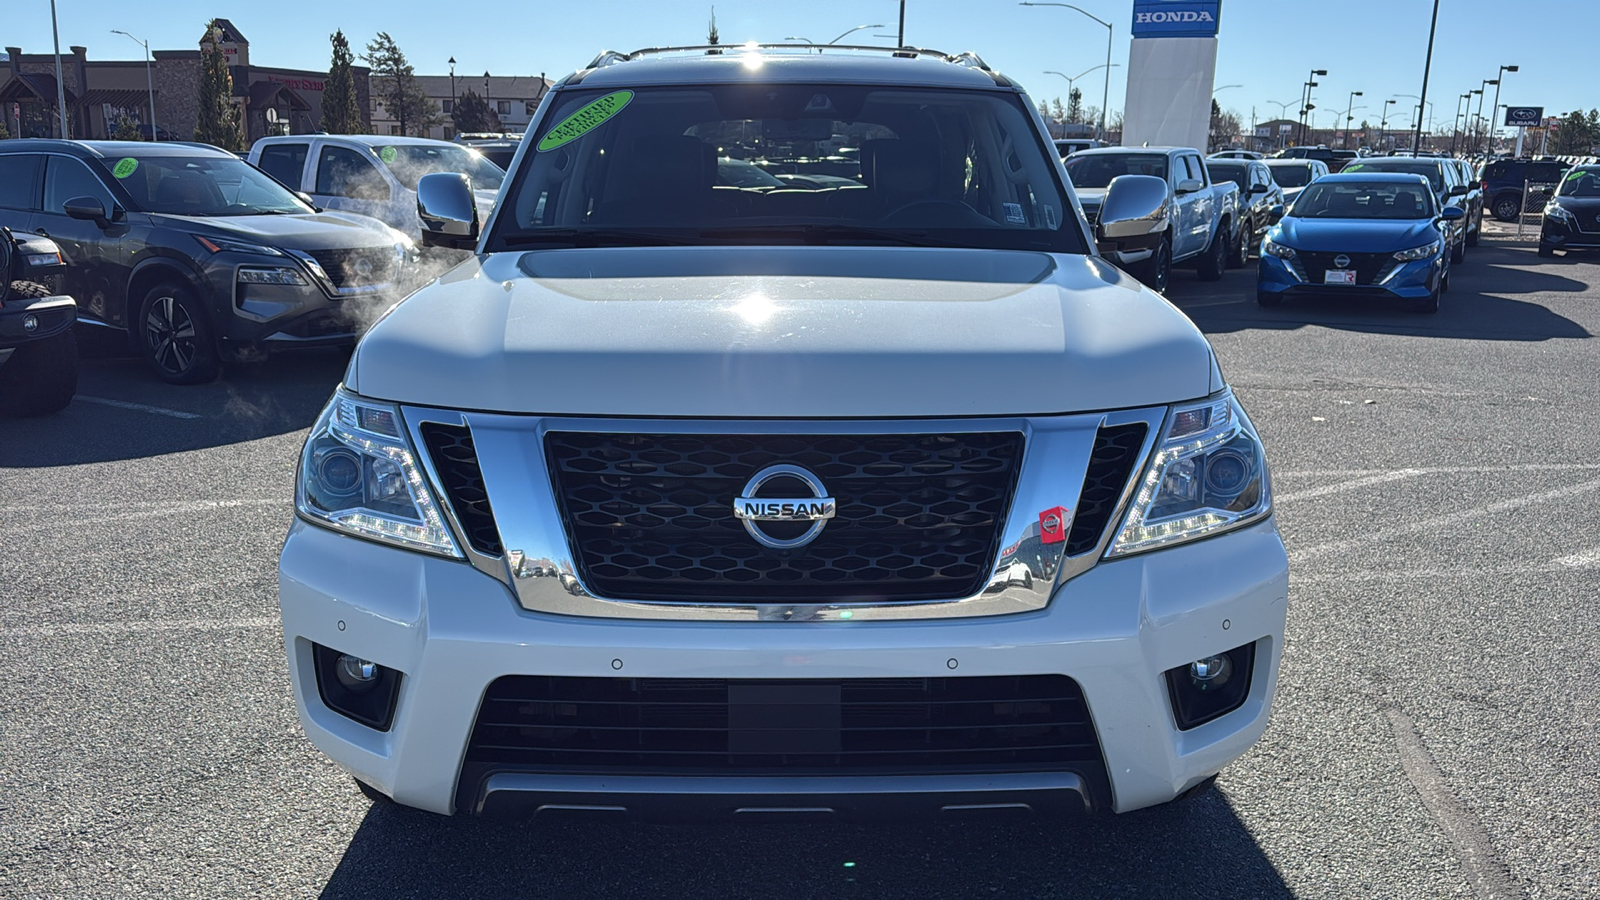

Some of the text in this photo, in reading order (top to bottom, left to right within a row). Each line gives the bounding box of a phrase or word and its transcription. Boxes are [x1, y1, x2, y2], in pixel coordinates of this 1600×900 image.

[1135, 11, 1214, 23] HONDA
[547, 95, 615, 140] CERTIFIED
[744, 502, 825, 516] NISSAN
